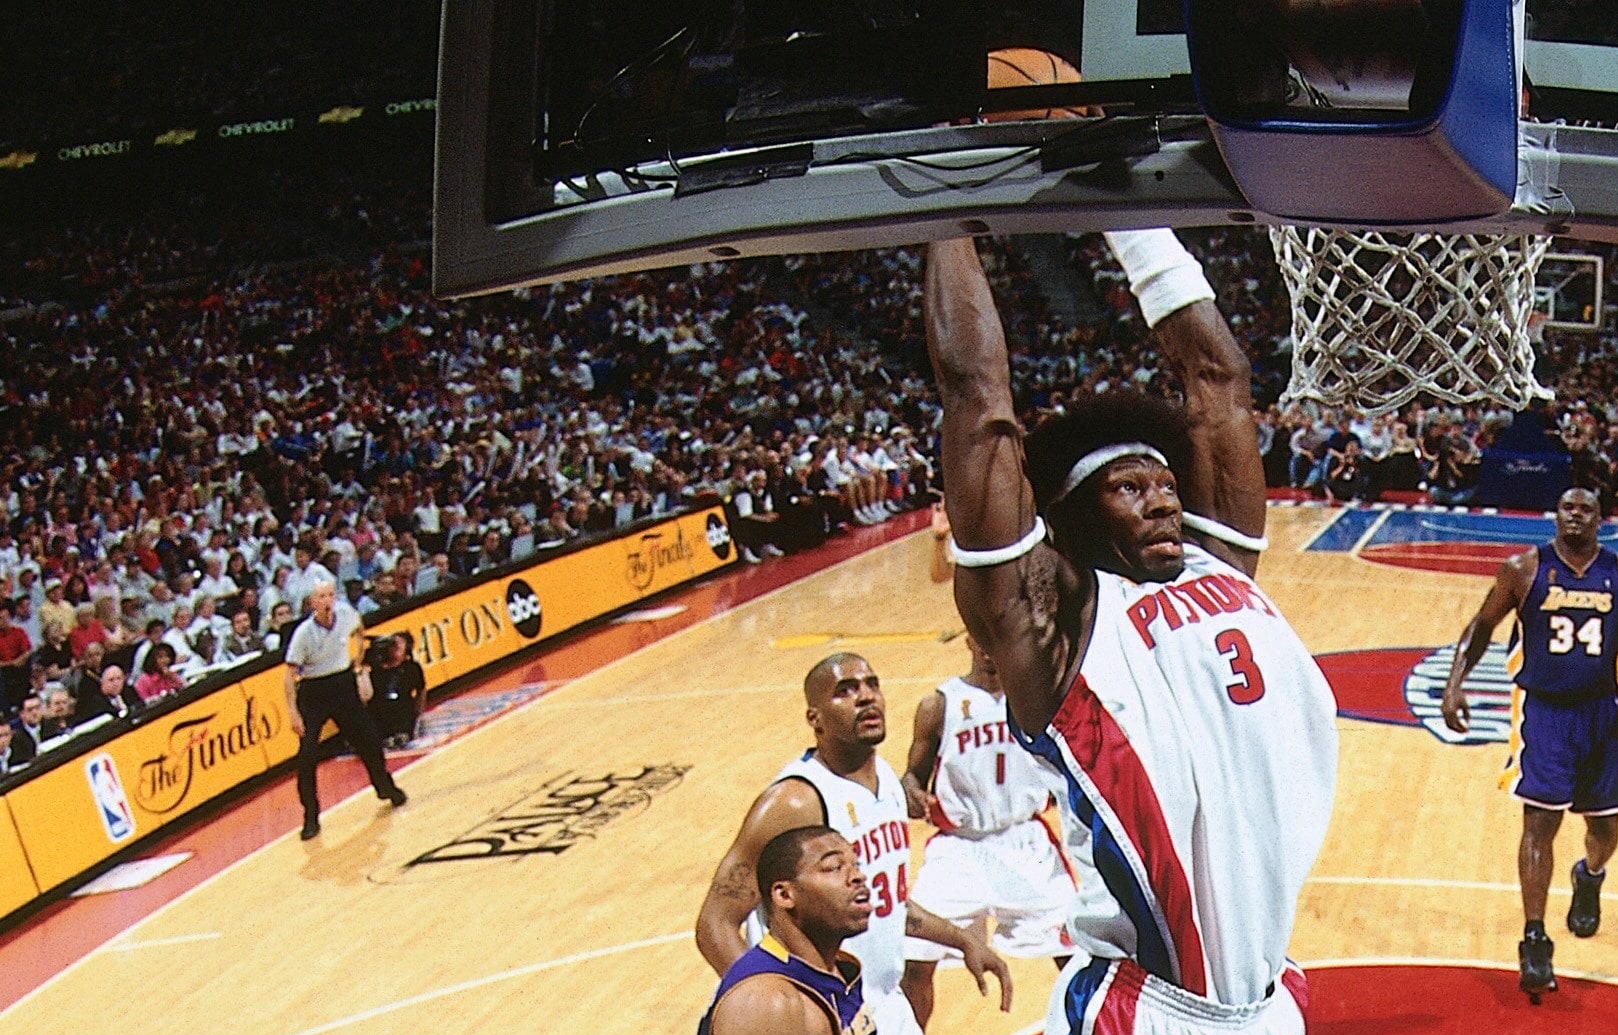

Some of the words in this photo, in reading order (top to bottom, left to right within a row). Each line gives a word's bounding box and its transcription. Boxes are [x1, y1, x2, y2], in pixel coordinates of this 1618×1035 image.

[385, 99, 437, 115] CHEVR
[218, 118, 295, 138] CHEVROLET
[57, 140, 131, 160] CHEVROLET
[705, 522, 731, 548] abc
[461, 599, 503, 648] ON
[508, 592, 541, 624] abc
[1549, 615, 1602, 656] 34
[1215, 628, 1266, 706] 3
[148, 697, 276, 813] Finals
[956, 721, 1015, 754] PIST
[137, 753, 181, 801] The
[996, 753, 1005, 785] 1
[872, 863, 907, 918] 34
